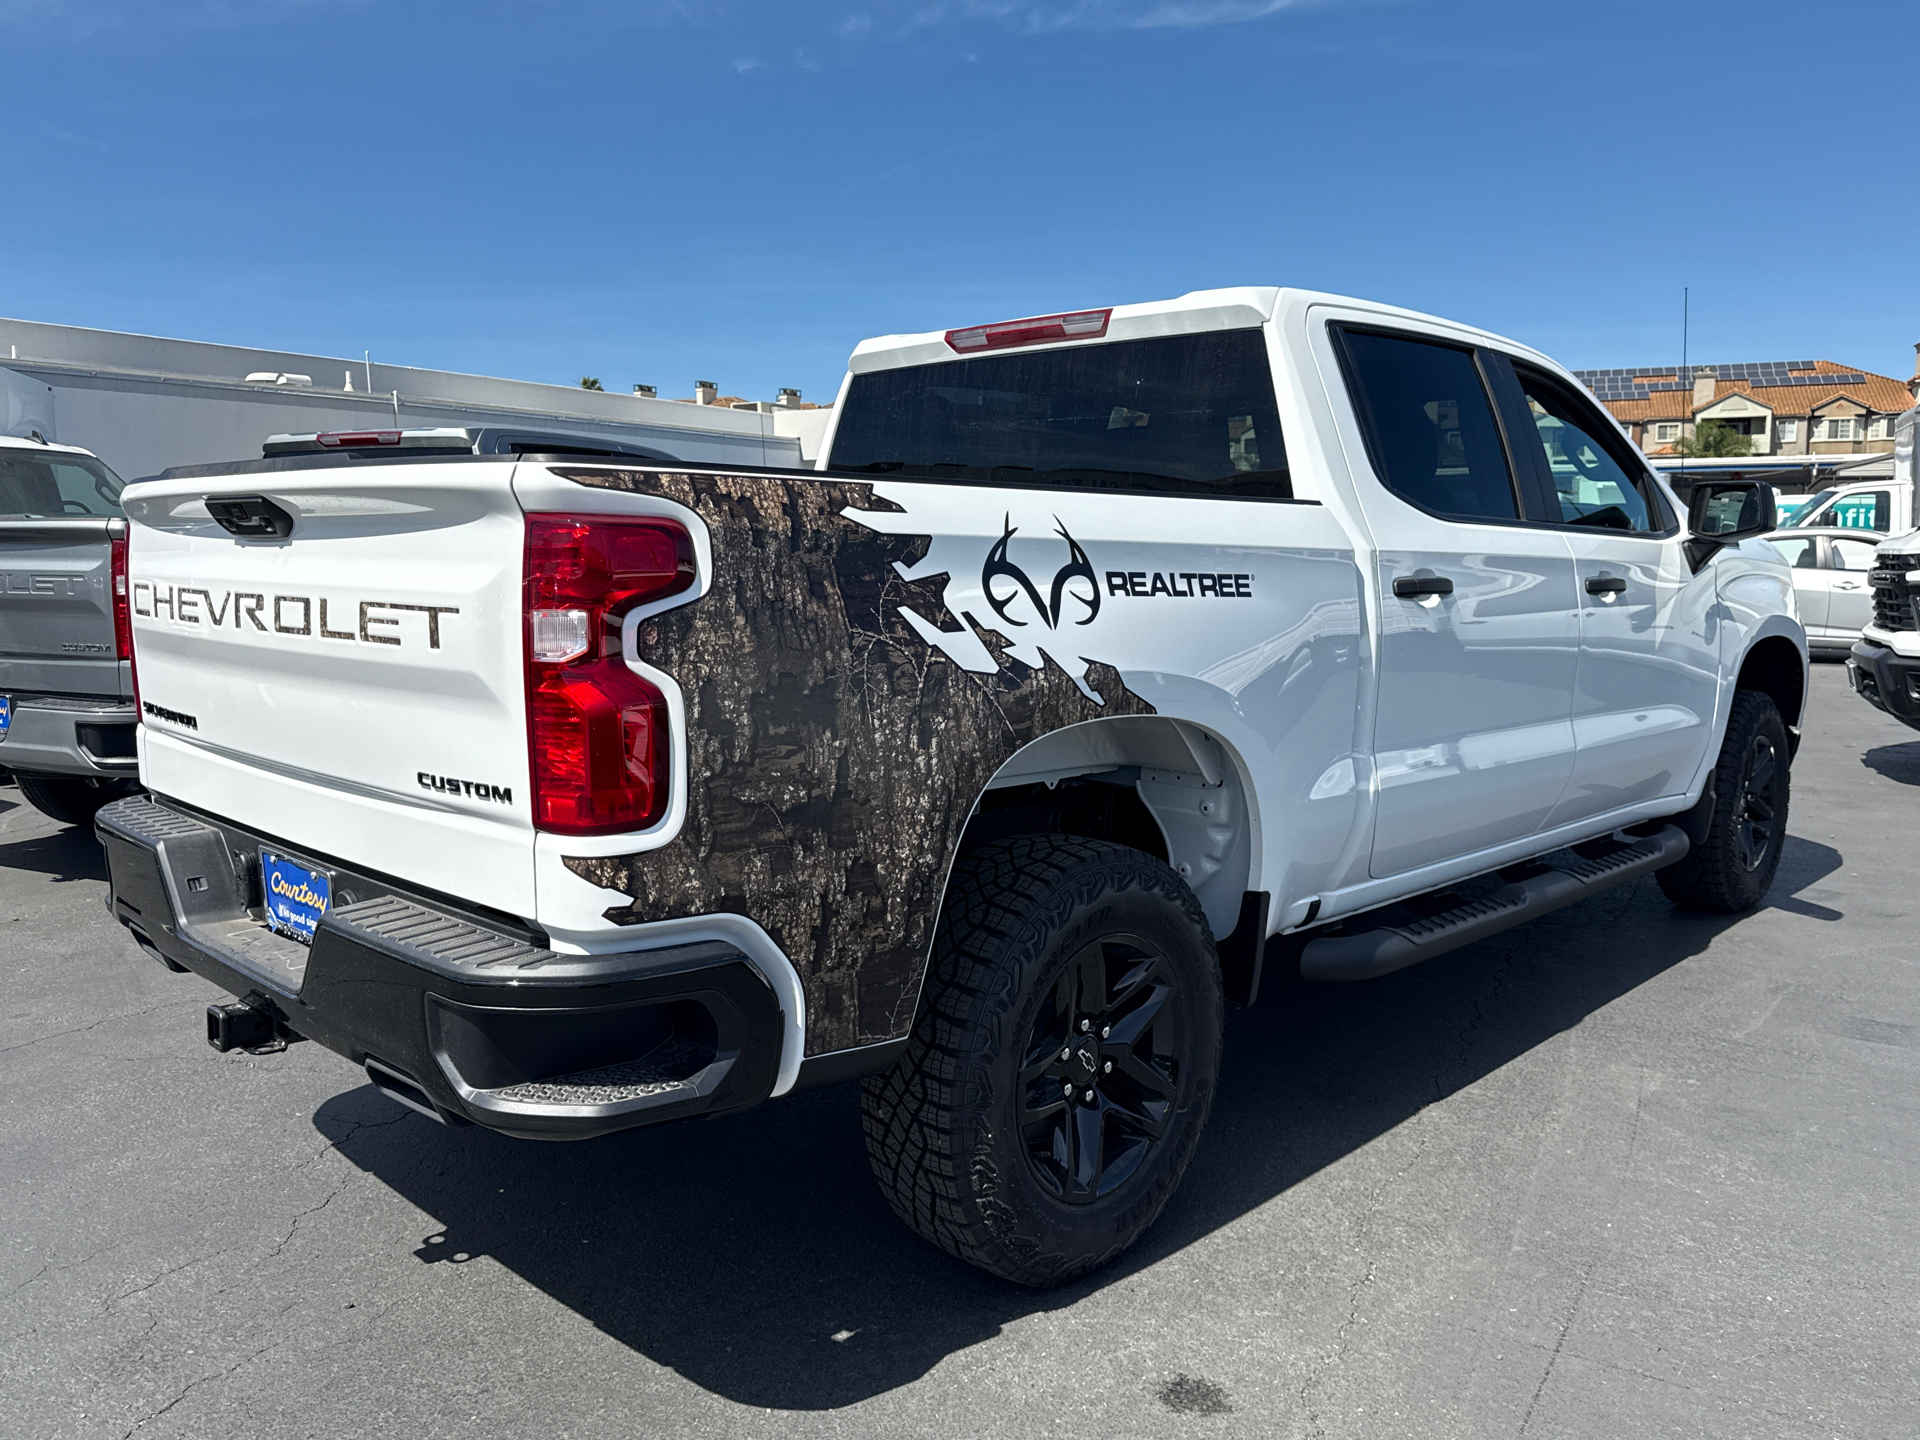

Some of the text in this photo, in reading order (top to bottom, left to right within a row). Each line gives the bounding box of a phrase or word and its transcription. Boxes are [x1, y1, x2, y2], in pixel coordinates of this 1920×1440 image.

[1105, 571, 1253, 598] REALTREE
[134, 583, 460, 650] CHEVROLET
[416, 771, 513, 804] CUSTOM
[270, 871, 328, 916] Courtesy
